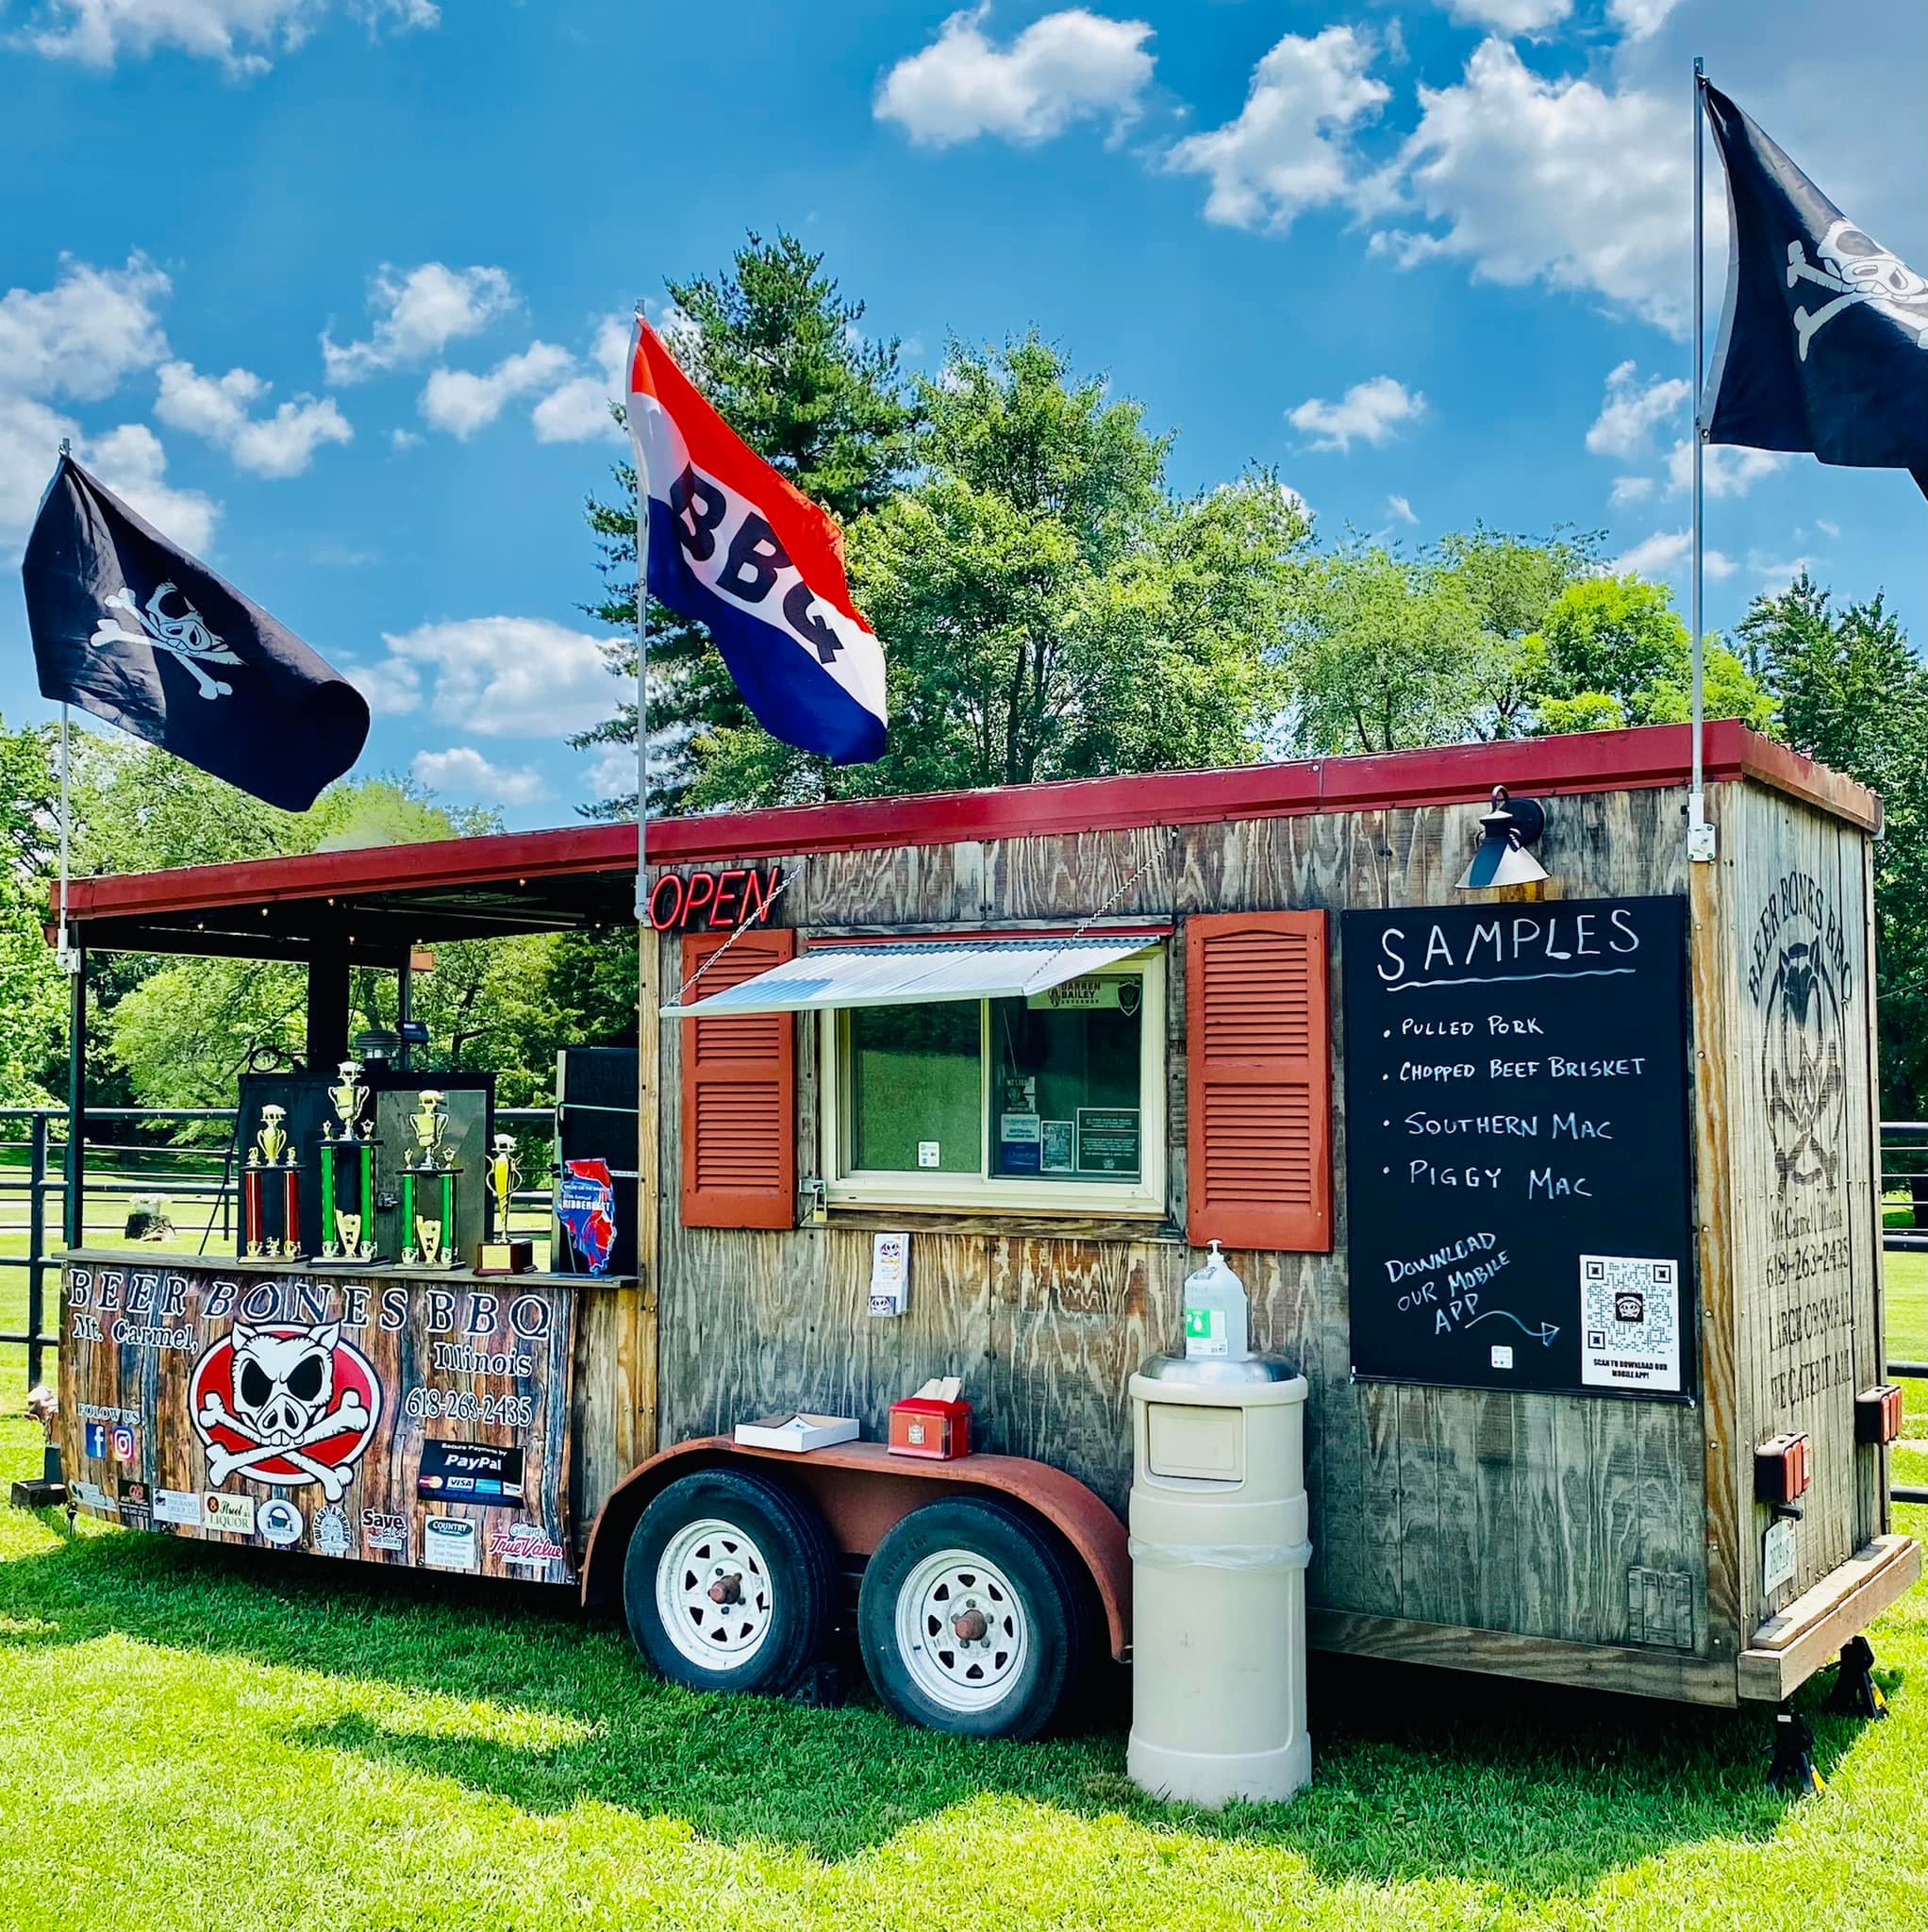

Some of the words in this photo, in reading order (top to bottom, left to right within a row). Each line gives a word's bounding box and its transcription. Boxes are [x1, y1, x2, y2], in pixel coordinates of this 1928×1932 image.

[670, 460, 845, 665] BBQ
[649, 866, 780, 931] OPEN
[1377, 909, 1640, 981] SAMPLES
[1748, 892, 1781, 1010] BEER
[1780, 870, 1824, 931] BONES
[1825, 904, 1853, 1011] BBQ
[1061, 991, 1096, 999] BAILEY
[1402, 1018, 1474, 1036] PULLED
[1488, 1014, 1545, 1036] PORK
[1399, 1061, 1476, 1082] CHOPPED
[1489, 1058, 1540, 1079] BEEF
[1547, 1056, 1646, 1078] BRISKET
[1404, 1111, 1538, 1138] SOUTHERN
[1552, 1111, 1614, 1141] MAC
[1409, 1159, 1503, 1189] PIGGY
[1528, 1167, 1593, 1201] MAC
[1385, 1232, 1497, 1284] DOWNLOAD
[1766, 1237, 1850, 1290] 618-263-2435
[1397, 1281, 1438, 1311] OUR
[1447, 1250, 1511, 1297] MOBILE
[68, 1268, 190, 1318] BEER
[201, 1280, 409, 1332] BONES
[424, 1289, 553, 1341] BBQ
[1434, 1292, 1479, 1335] APP
[73, 1312, 104, 1343] Mt.
[111, 1317, 200, 1356] Carmel,
[433, 1341, 533, 1377] Illinois
[1620, 1360, 1654, 1371] DOWNLOAD
[77, 1403, 121, 1422] FOLOW
[122, 1408, 141, 1424] US
[405, 1387, 533, 1427] 618-263-2435
[443, 1454, 502, 1471] PayPal
[451, 1478, 473, 1487] VISA
[209, 1513, 250, 1529] LIQUOR
[314, 1507, 328, 1541] OUTCAST
[331, 1507, 352, 1546] ARBRUSH
[362, 1509, 406, 1529] Save
[432, 1521, 468, 1533] COUNTRY
